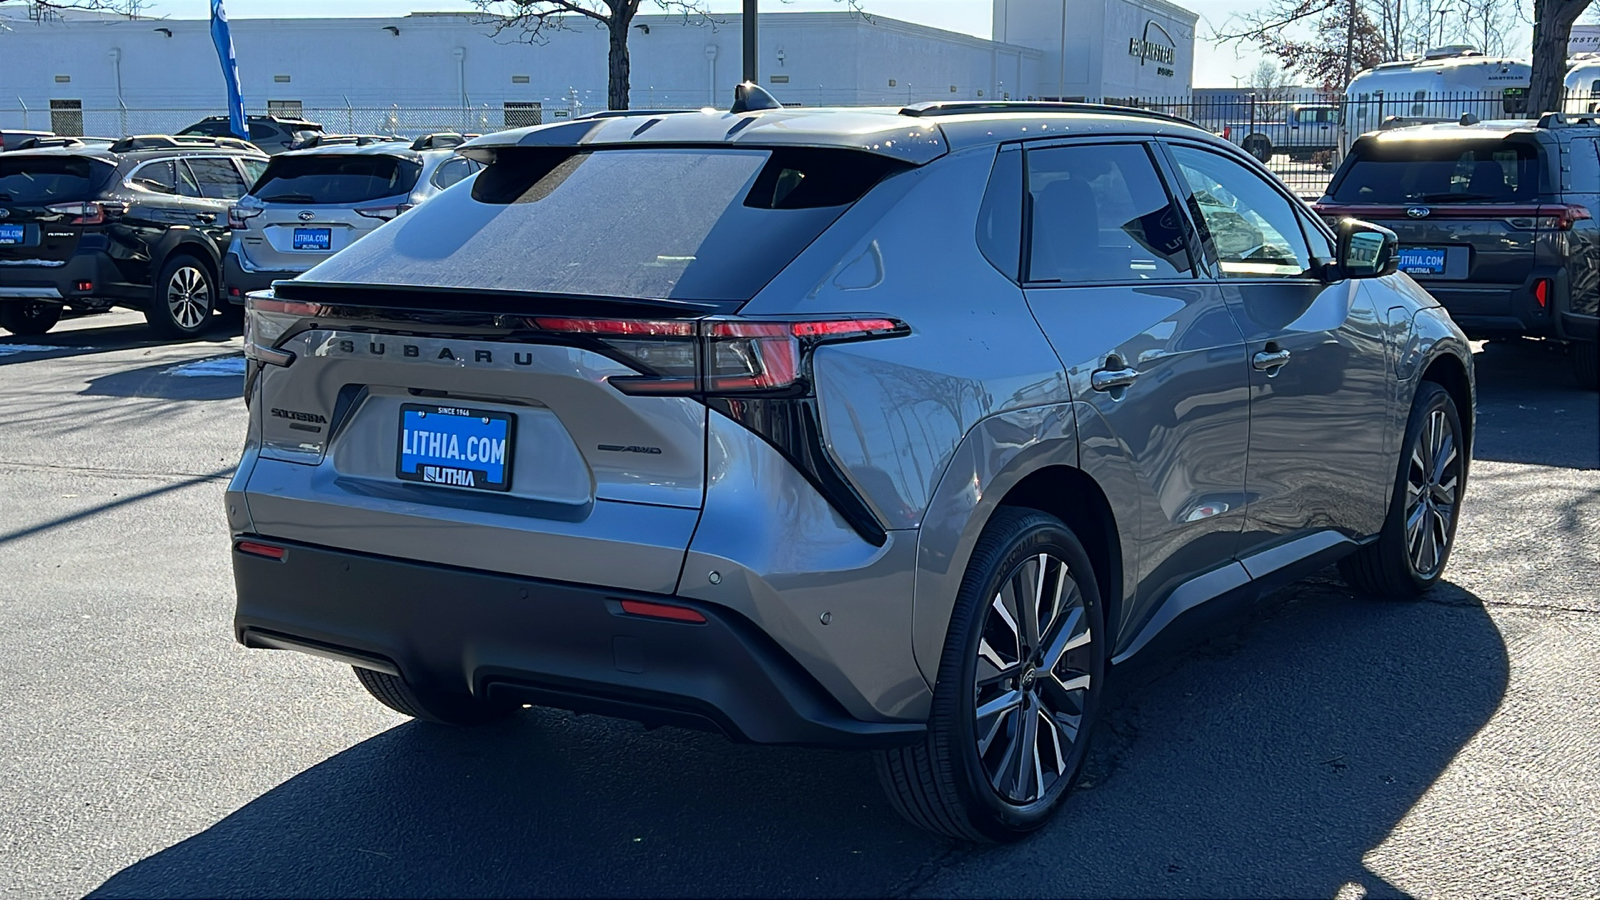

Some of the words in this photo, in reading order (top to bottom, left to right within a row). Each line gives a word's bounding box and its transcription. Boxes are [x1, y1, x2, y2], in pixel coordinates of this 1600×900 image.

[294, 234, 329, 243] LITHIA.COM
[339, 339, 533, 366] SUBARU
[271, 407, 328, 425] SOLTERRA
[438, 407, 456, 416] SINCE
[456, 408, 470, 417] 1946
[402, 428, 506, 465] LITHIA.COM
[621, 445, 662, 455] AWD
[435, 466, 475, 487] LITHIA
